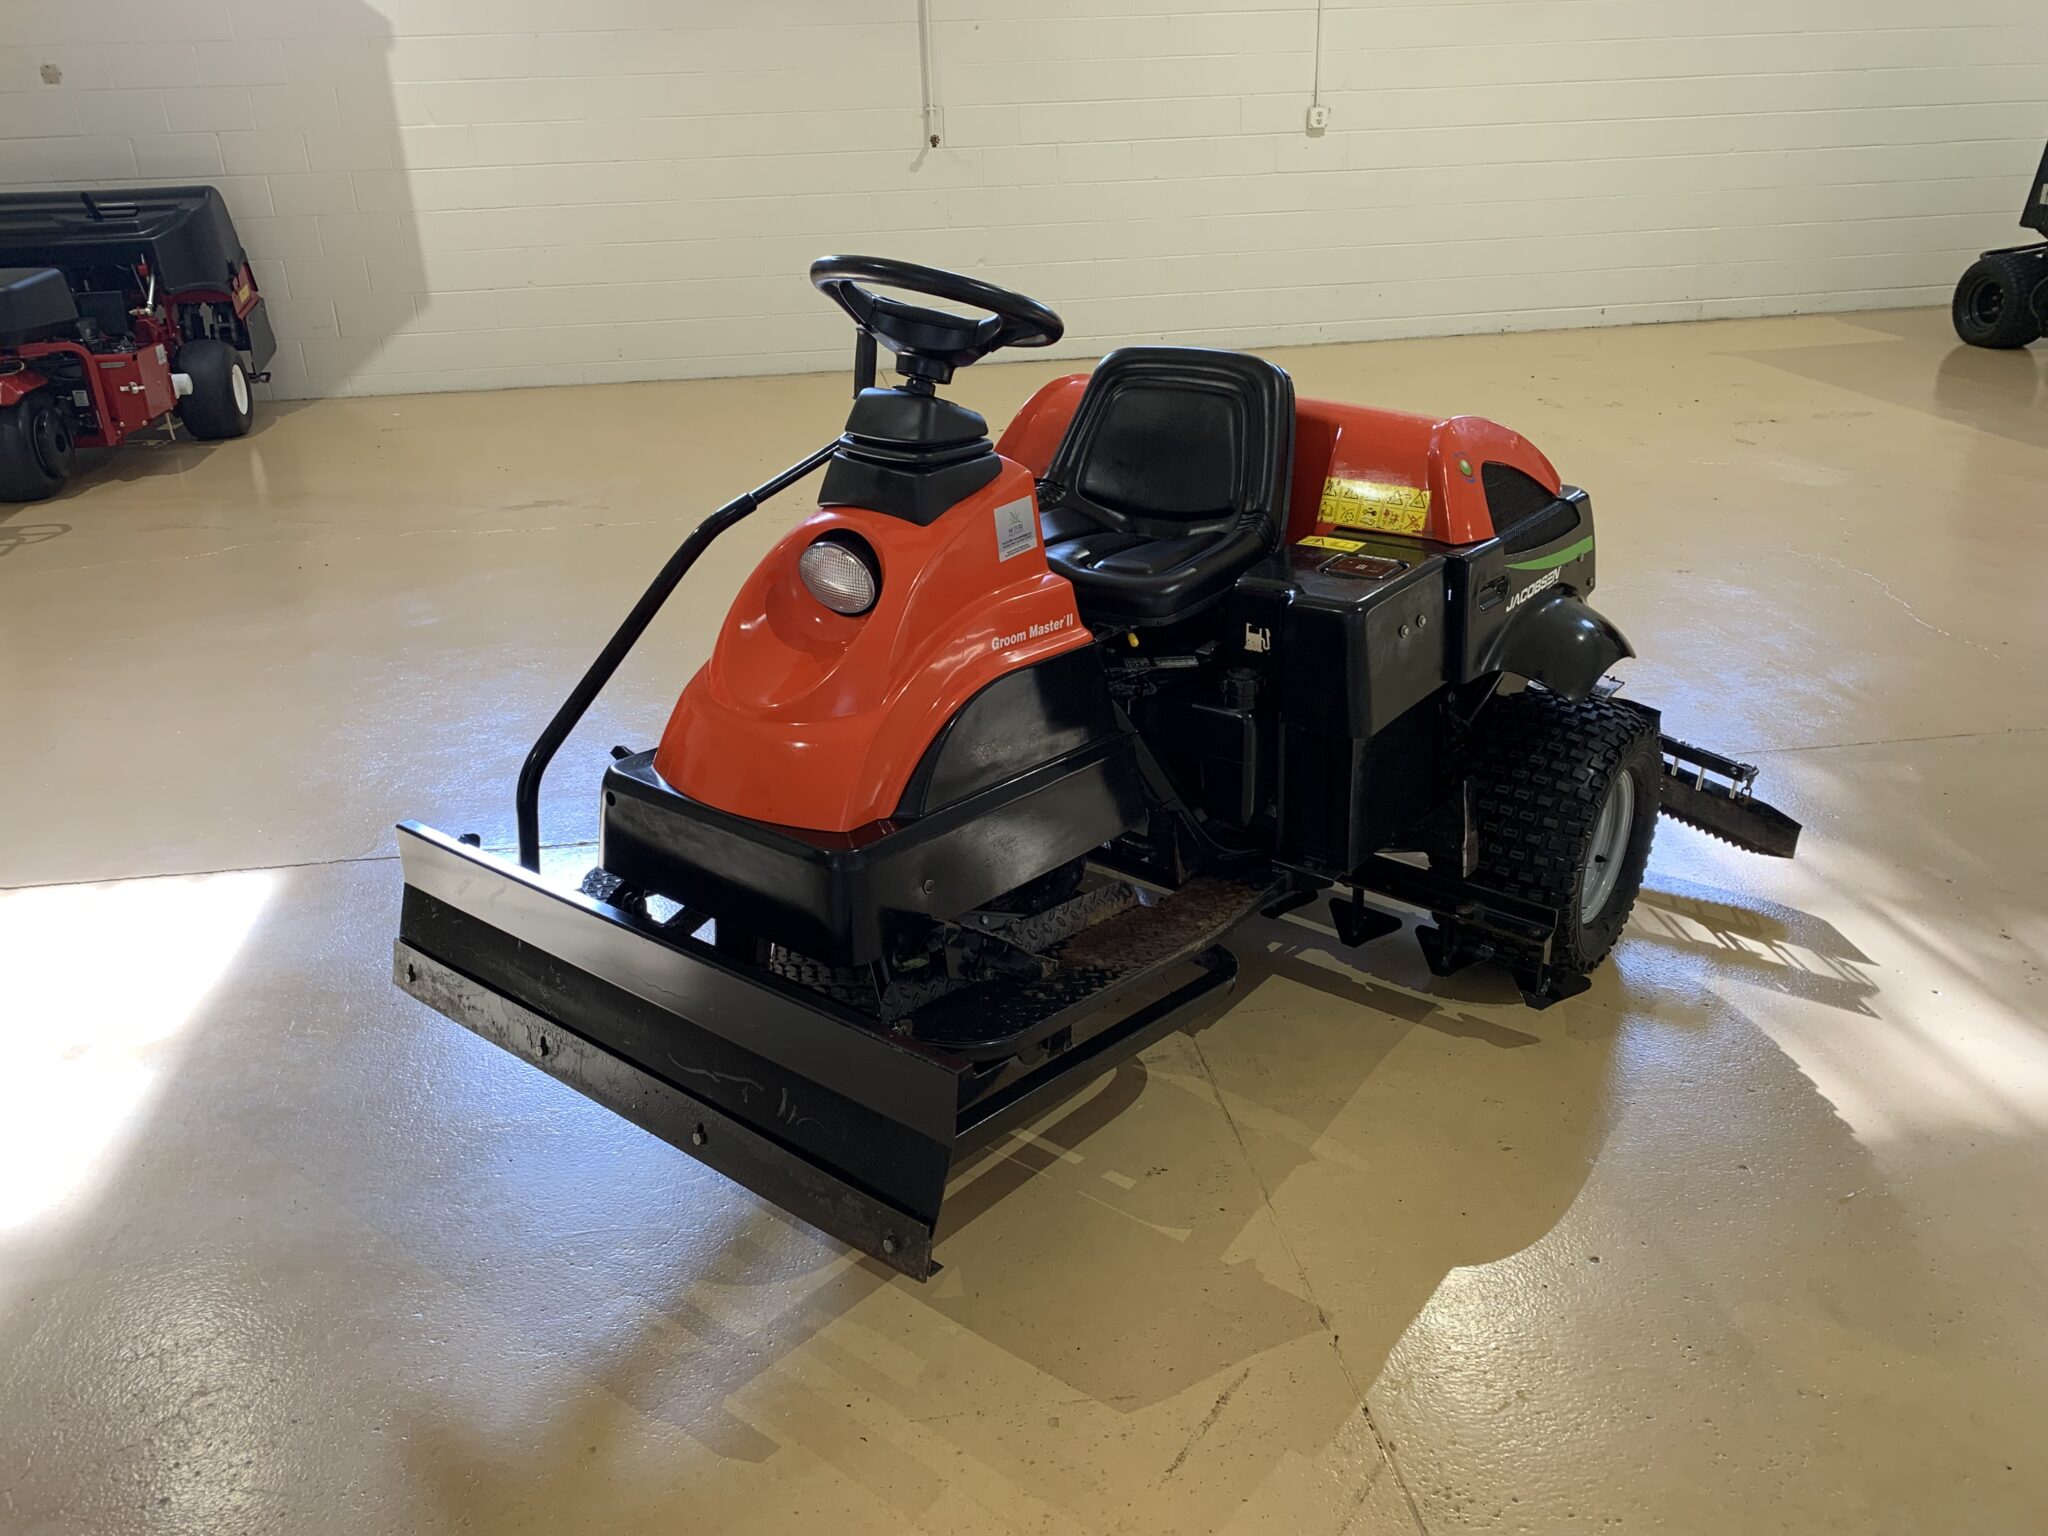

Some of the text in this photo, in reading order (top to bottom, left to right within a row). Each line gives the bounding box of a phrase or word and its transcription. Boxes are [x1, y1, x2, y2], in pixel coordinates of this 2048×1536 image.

[1505, 565, 1562, 612] JACOBSEN
[991, 612, 1074, 651] Groom Master II
